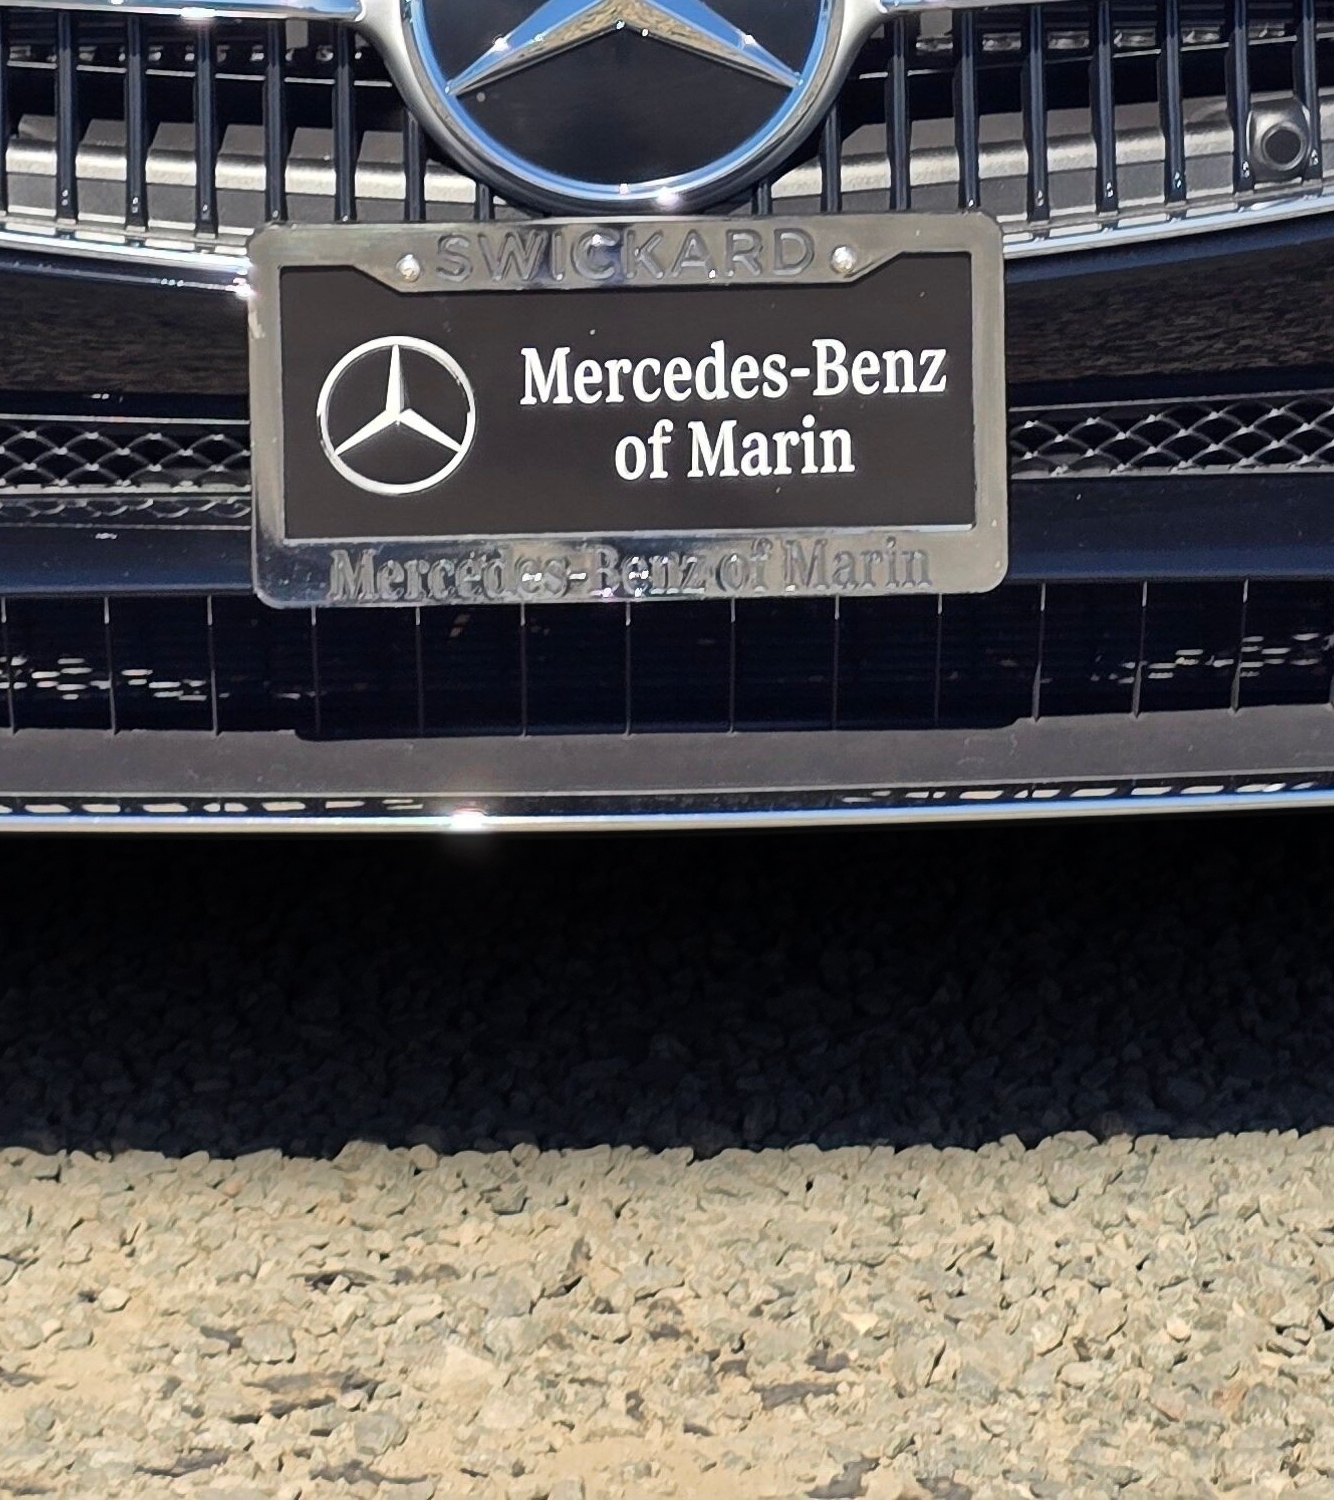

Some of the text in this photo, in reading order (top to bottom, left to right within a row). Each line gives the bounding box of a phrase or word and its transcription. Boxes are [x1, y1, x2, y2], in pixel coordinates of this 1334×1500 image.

[435, 228, 816, 282] SWICKARD
[520, 338, 948, 407] Mercedes-Benz
[614, 415, 855, 481] of Marin
[328, 535, 931, 602] Mercedes-Benz of Marin
